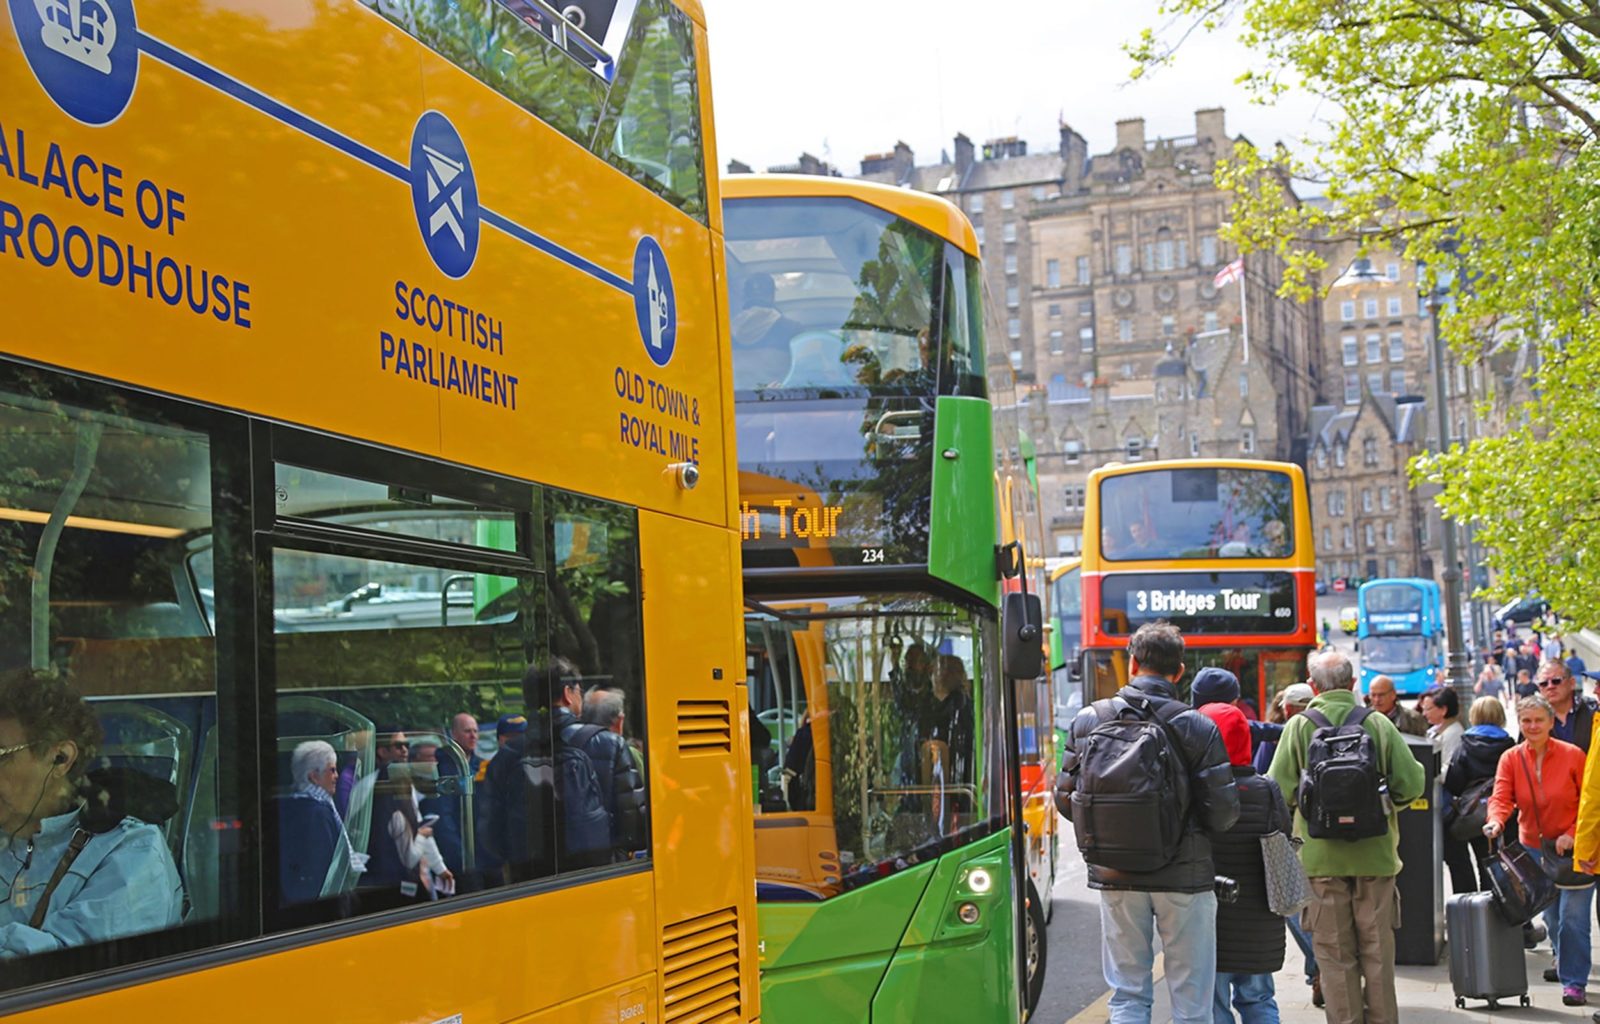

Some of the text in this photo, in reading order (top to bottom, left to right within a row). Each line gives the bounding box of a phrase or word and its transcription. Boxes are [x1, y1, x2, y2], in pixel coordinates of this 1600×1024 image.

[136, 179, 186, 236] OF
[0, 201, 251, 328] ROODHOUSE
[395, 280, 503, 356] SCOTTISH
[380, 331, 519, 411] PARLIAMENT
[615, 366, 700, 426] OLD TOWN &
[620, 412, 699, 466] ROYAL MILE
[773, 499, 843, 539] Tour
[862, 549, 885, 563] 234
[1136, 588, 1261, 616] 3 Bridges Tour
